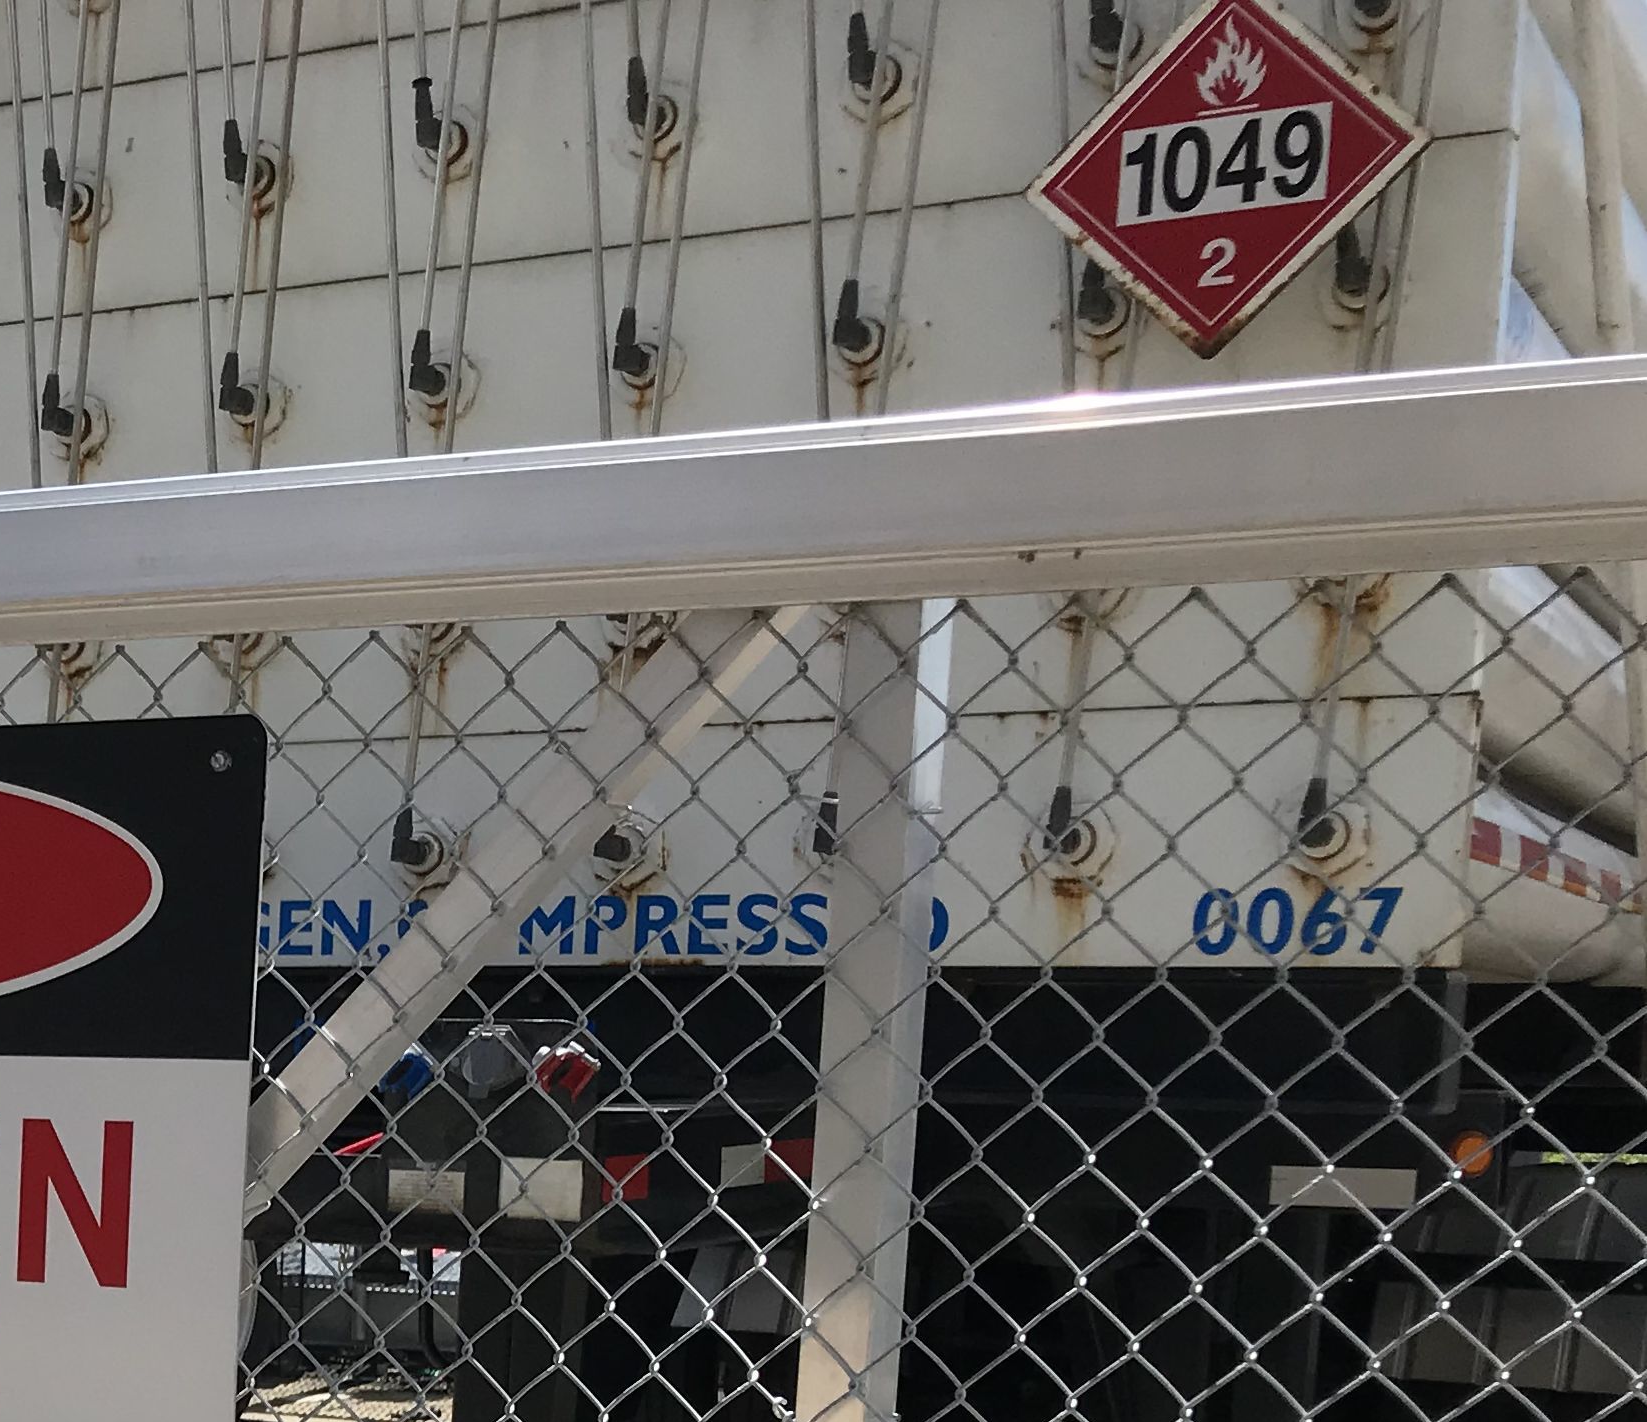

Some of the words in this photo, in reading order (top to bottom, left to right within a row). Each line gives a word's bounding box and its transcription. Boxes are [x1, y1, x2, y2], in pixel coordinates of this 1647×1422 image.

[1126, 110, 1323, 216] 1049
[1197, 237, 1236, 287] 2
[1193, 886, 1403, 955] 0067
